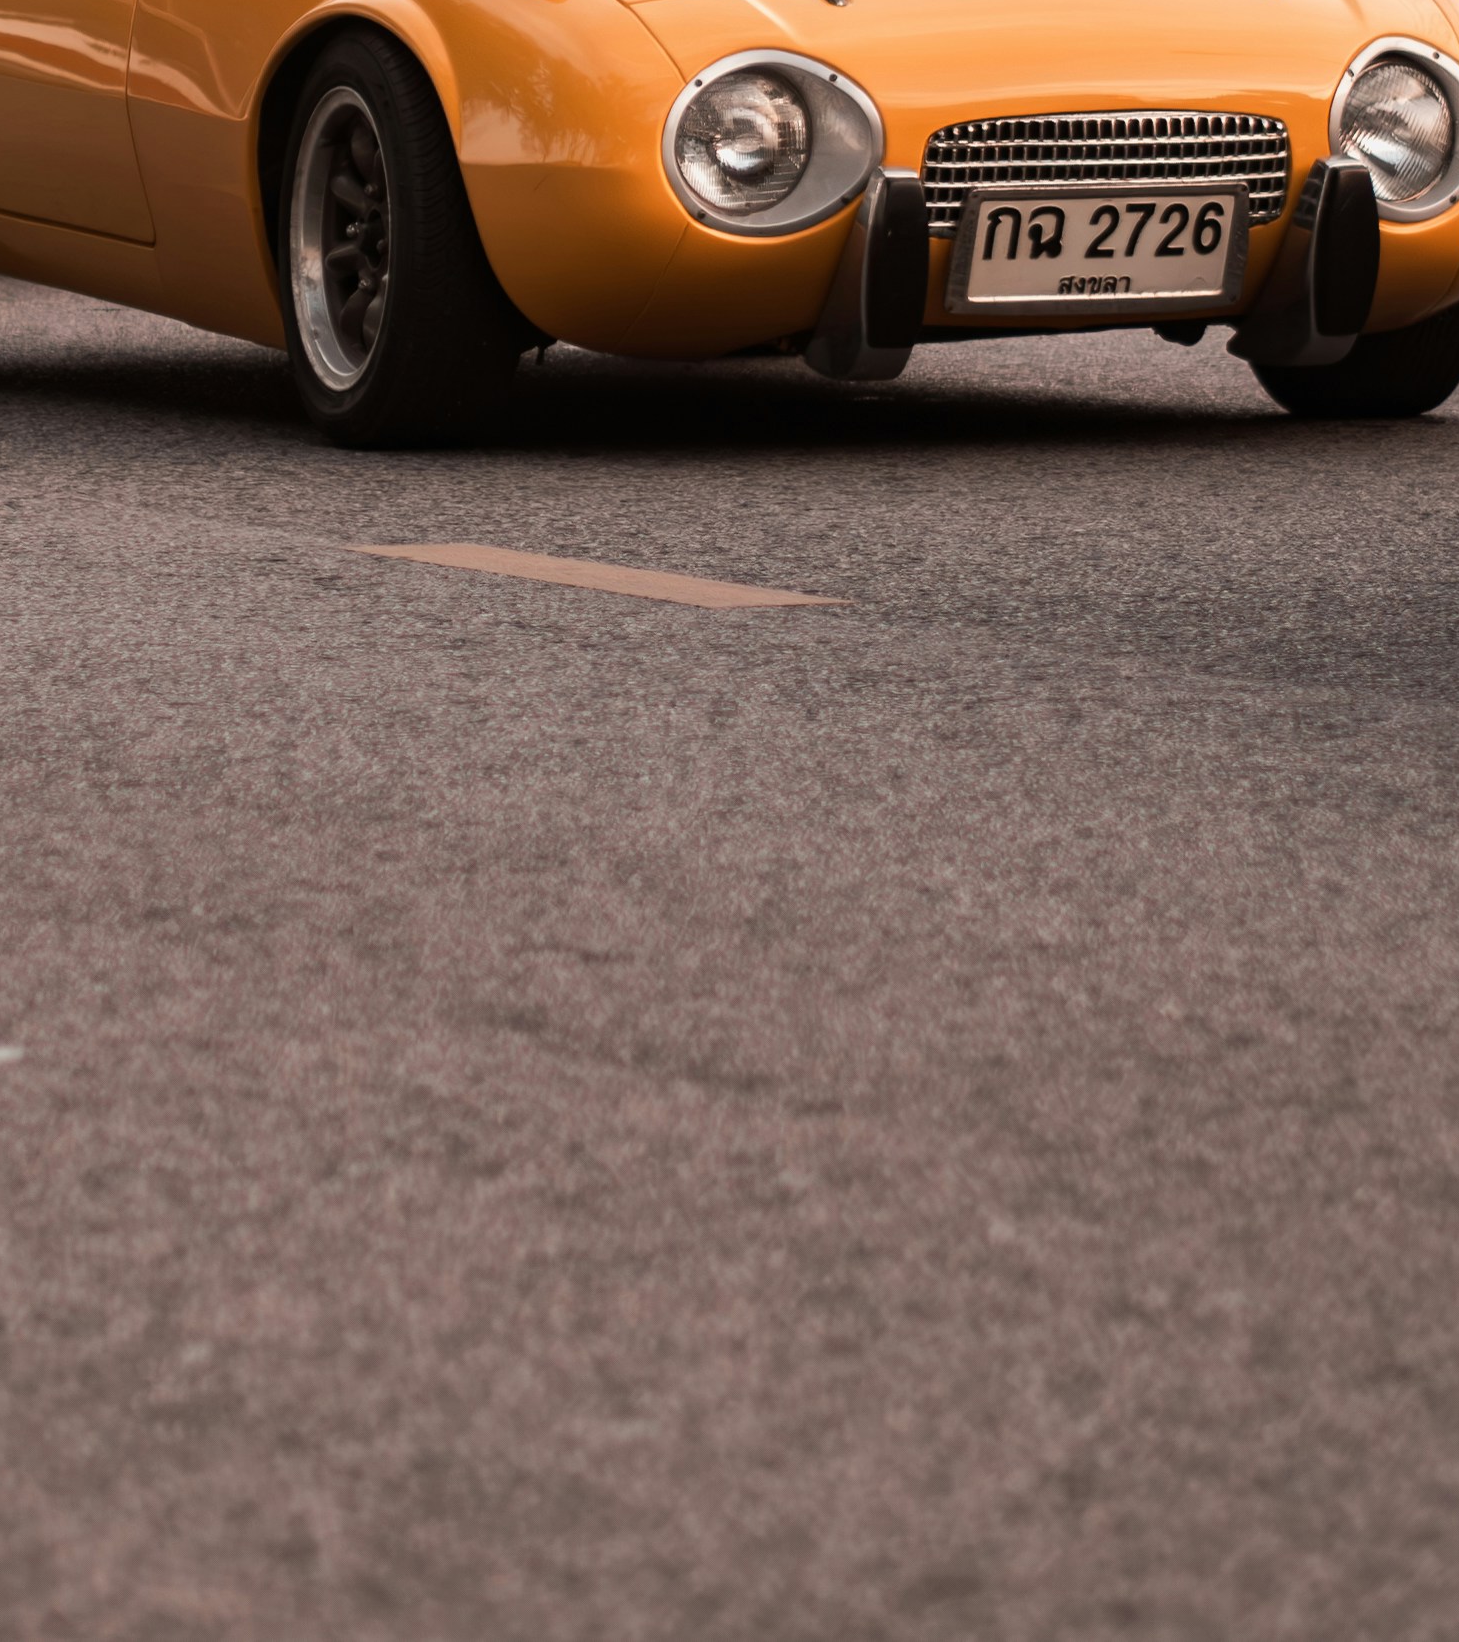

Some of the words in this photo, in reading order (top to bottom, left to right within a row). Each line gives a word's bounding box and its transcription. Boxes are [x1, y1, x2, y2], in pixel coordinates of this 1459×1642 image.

[982, 205, 1066, 260] กฉ
[1085, 201, 1225, 258] 2726
[1058, 273, 1133, 295] สงขลา
